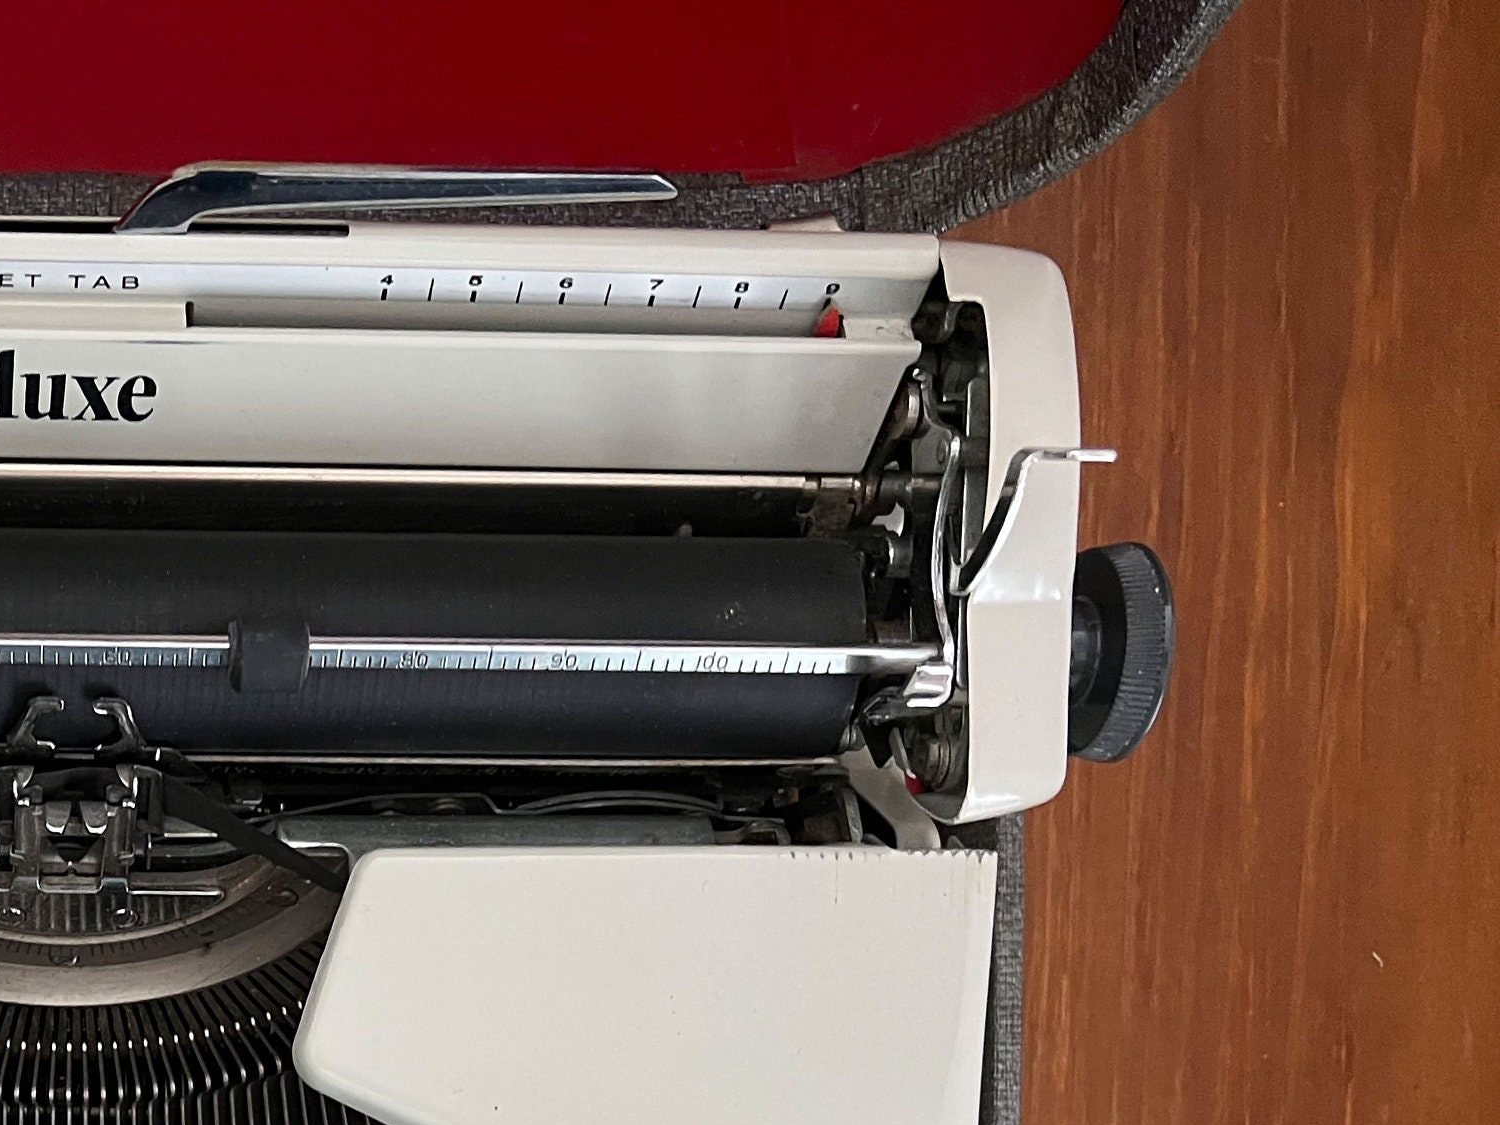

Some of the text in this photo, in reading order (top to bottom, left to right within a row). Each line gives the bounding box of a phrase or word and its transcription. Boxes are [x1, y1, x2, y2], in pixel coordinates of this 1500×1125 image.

[69, 275, 138, 289] TAB
[381, 275, 840, 295] 4 5 6 7 8 9
[551, 650, 578, 669] 90
